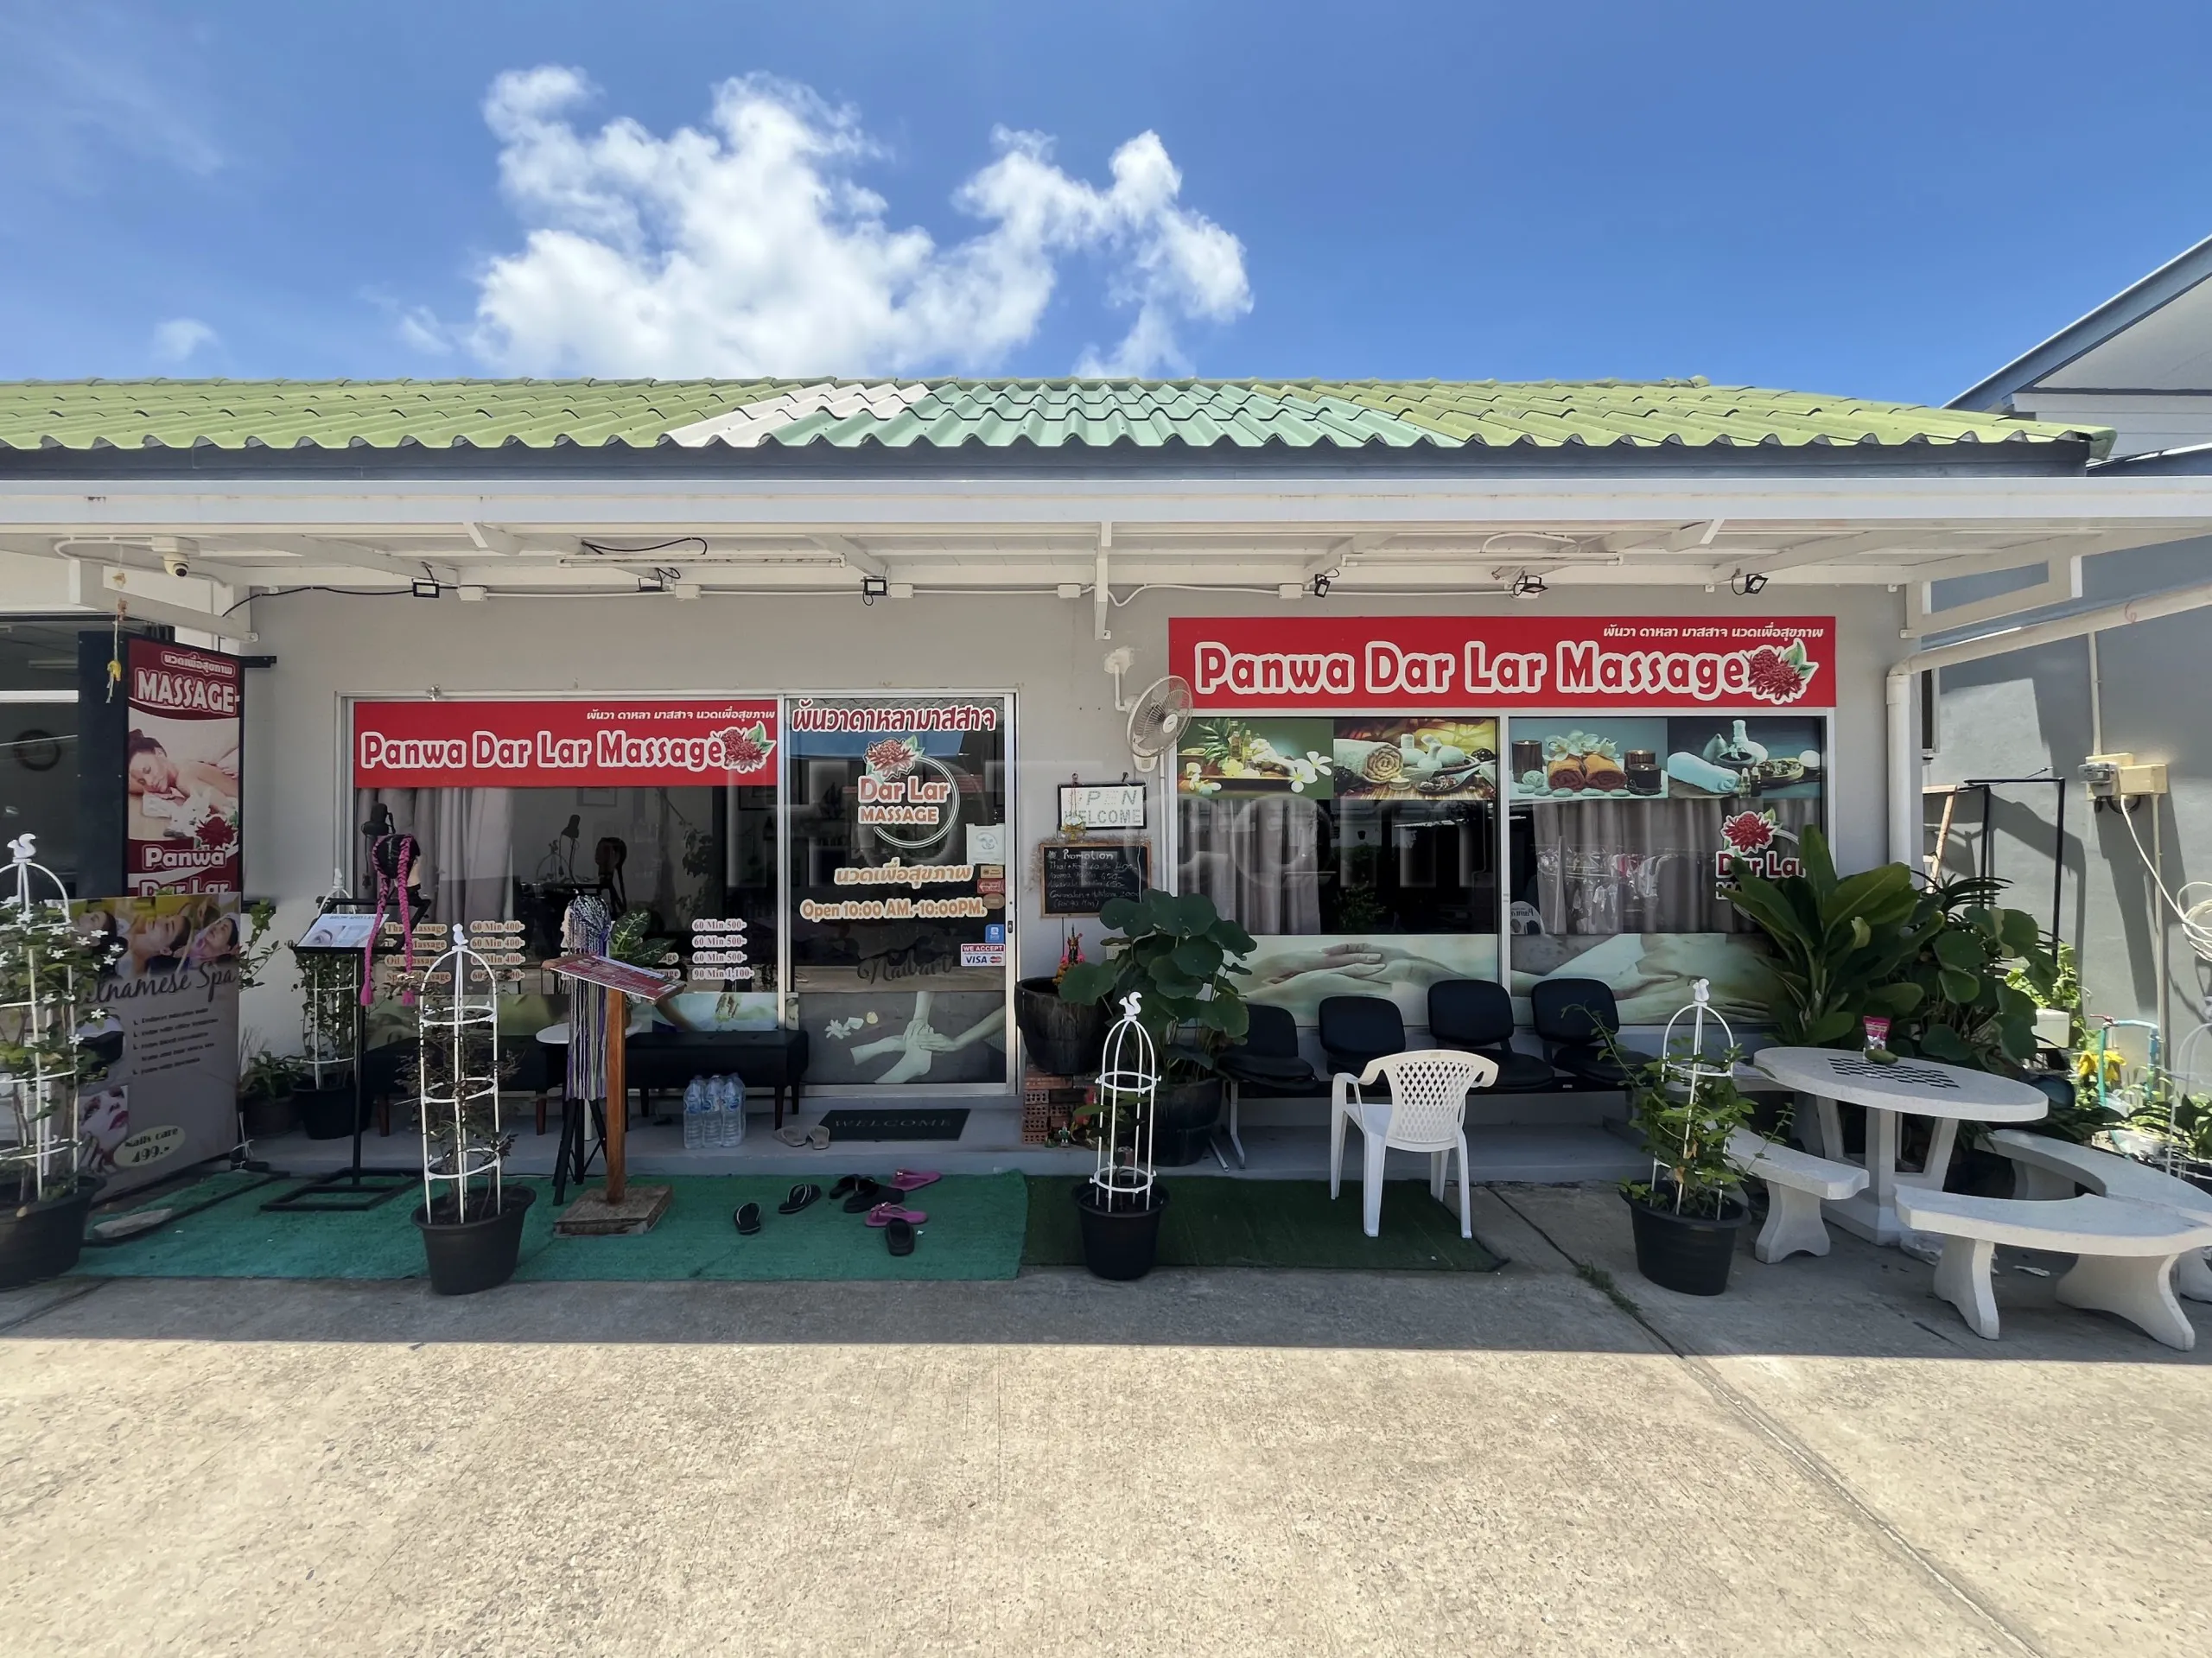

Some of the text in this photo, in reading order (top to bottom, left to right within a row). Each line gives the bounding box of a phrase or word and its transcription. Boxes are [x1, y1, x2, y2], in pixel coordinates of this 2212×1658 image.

[1732, 621, 1824, 641] นวดเพื่อสุขภาพ
[1197, 643, 1746, 698] Panwa Dar Lar Massage
[137, 670, 235, 714] MASSAGE
[363, 733, 723, 771] Panwa Dar Lar Massage
[860, 777, 949, 801] Dar Lar
[860, 807, 938, 823] MASSAGE
[144, 847, 226, 867] Panwa
[1062, 848, 1114, 860] Promotion
[1717, 852, 1762, 877] Dr
[836, 860, 972, 886] นวดเพื่อสุขภาพ
[141, 881, 186, 897] Dr
[804, 902, 840, 918] Open
[843, 902, 882, 916] 10:00
[387, 924, 446, 935] Tha assage
[472, 922, 482, 931] 60
[485, 922, 502, 931] Min
[693, 921, 704, 931] 60
[707, 921, 724, 931] Min
[472, 938, 482, 948] 60
[485, 938, 502, 948] Min
[693, 937, 704, 946] 60
[707, 937, 724, 946] Min
[386, 956, 400, 966] Oil
[485, 955, 502, 964] Min
[693, 953, 704, 962] 60
[707, 953, 724, 962] Min
[196, 961, 237, 1002] Spa
[693, 969, 704, 979] 90
[707, 969, 724, 979] Min
[155, 1128, 178, 1140] care
